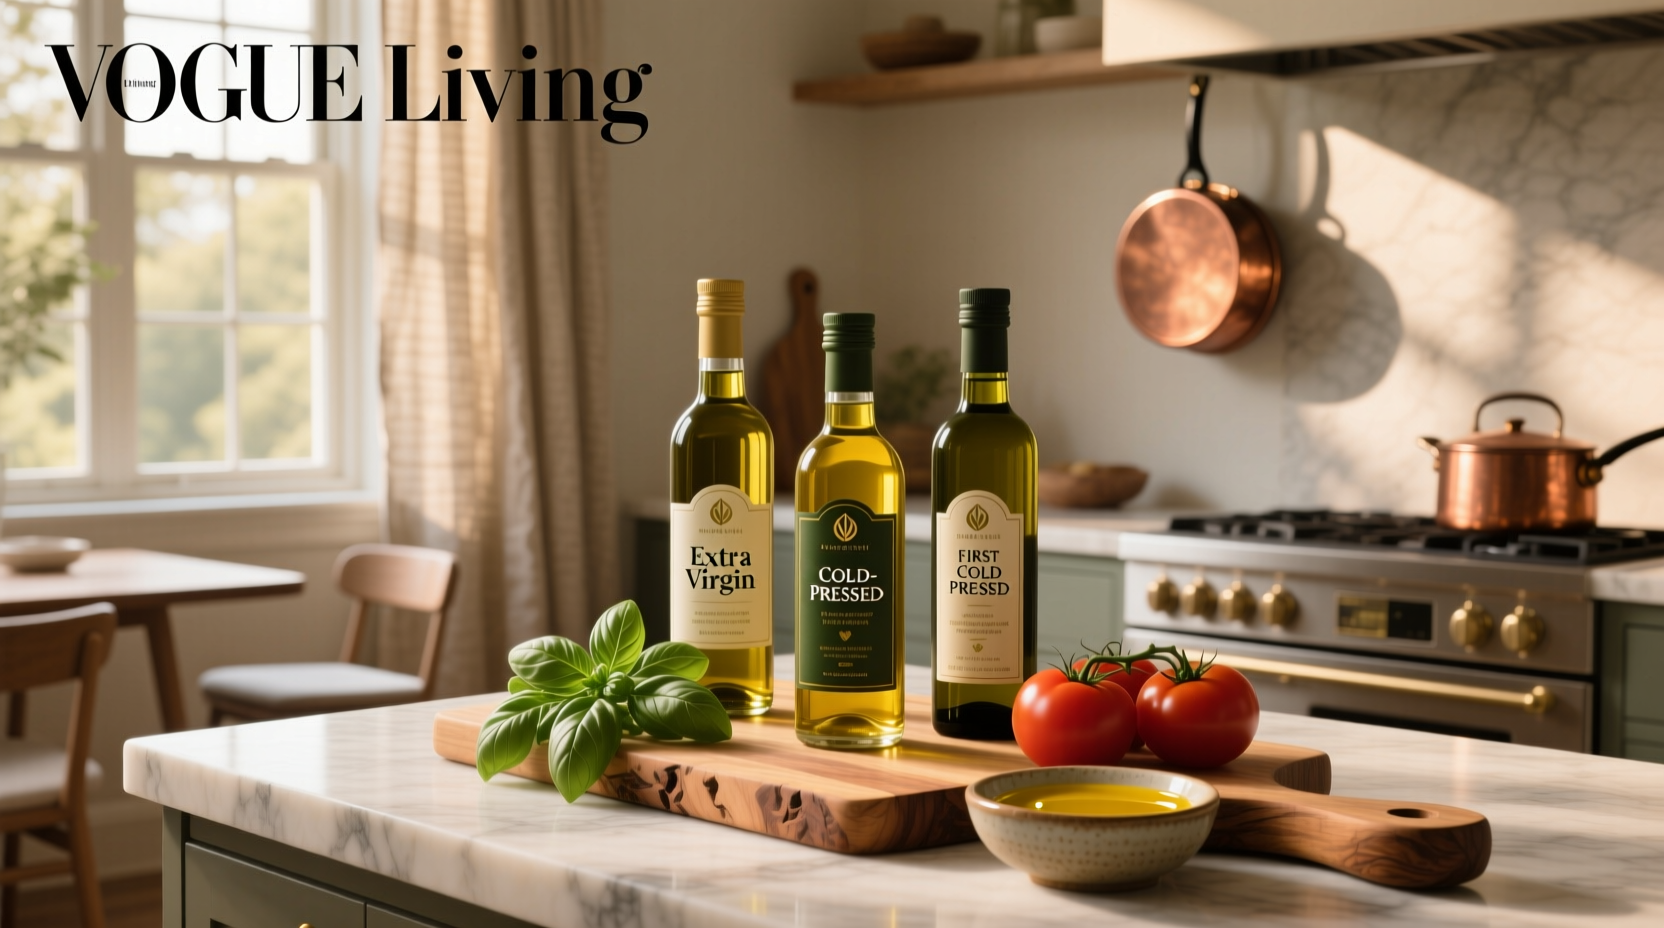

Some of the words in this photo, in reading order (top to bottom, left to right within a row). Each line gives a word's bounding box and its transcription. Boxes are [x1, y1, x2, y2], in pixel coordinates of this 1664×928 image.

[690, 546, 752, 567] Extra
[958, 549, 1000, 563] FIRST
[818, 566, 878, 583] COLD-
[956, 564, 1003, 579] COLD
[685, 568, 756, 596] Virgin
[949, 580, 1010, 596] PRESSD
[810, 584, 884, 602] PRESSED
